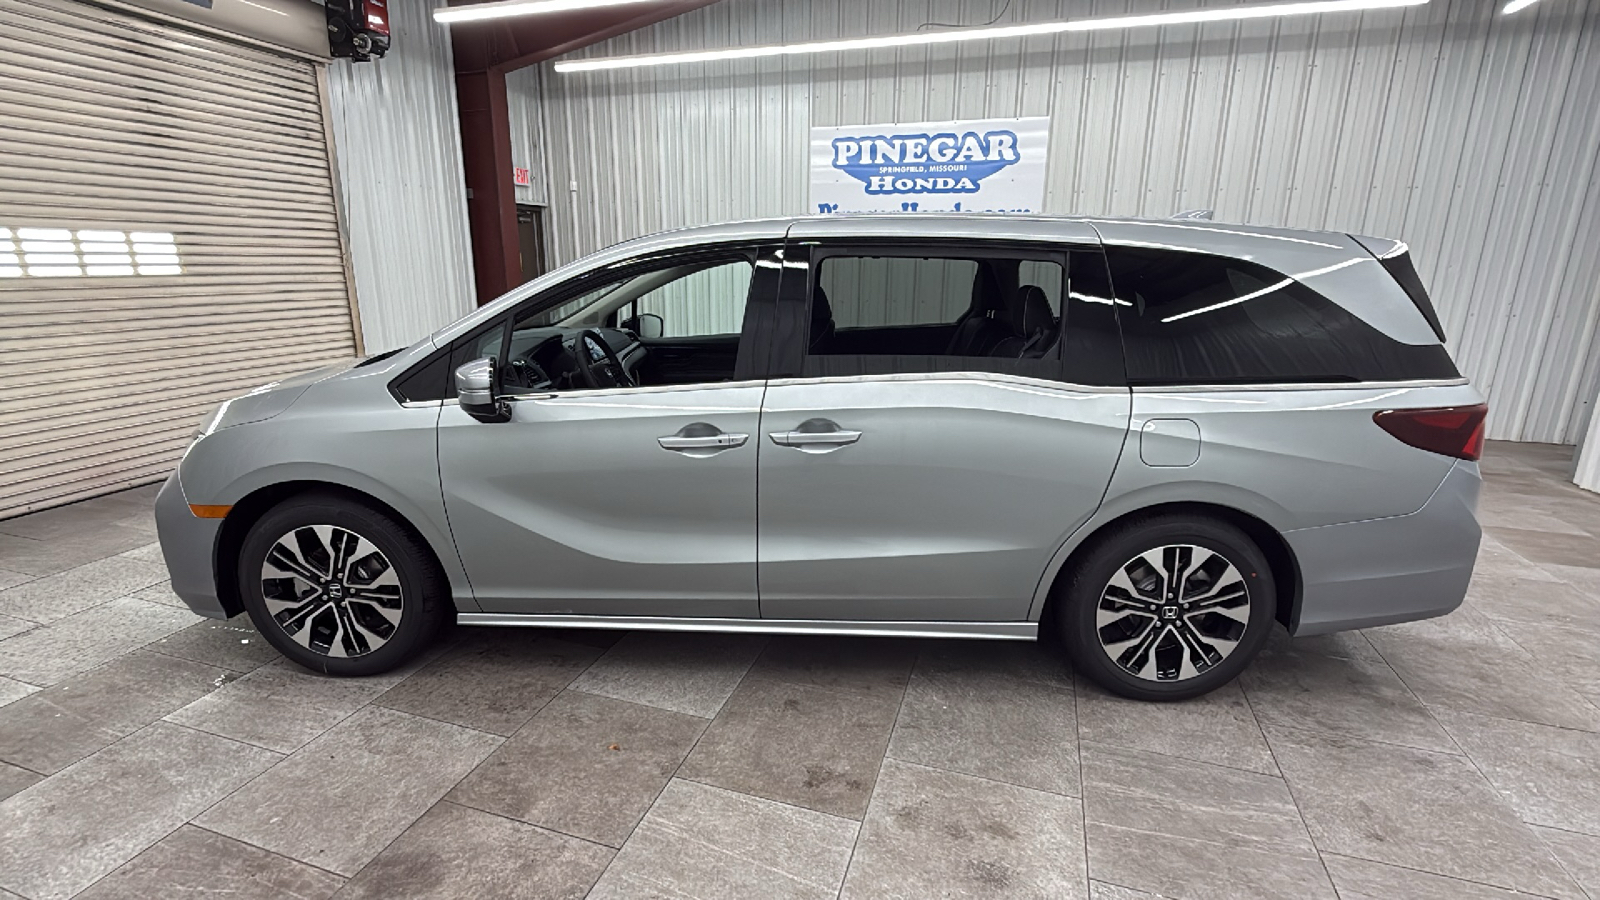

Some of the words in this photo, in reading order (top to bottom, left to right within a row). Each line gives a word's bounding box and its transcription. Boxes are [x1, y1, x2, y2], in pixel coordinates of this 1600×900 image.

[834, 134, 1017, 166] PINEGAR
[516, 167, 529, 184] EXIT
[879, 166, 928, 174] SPRINGFIELD,
[929, 164, 968, 172] MISSOURI
[868, 176, 976, 191] HONDA
